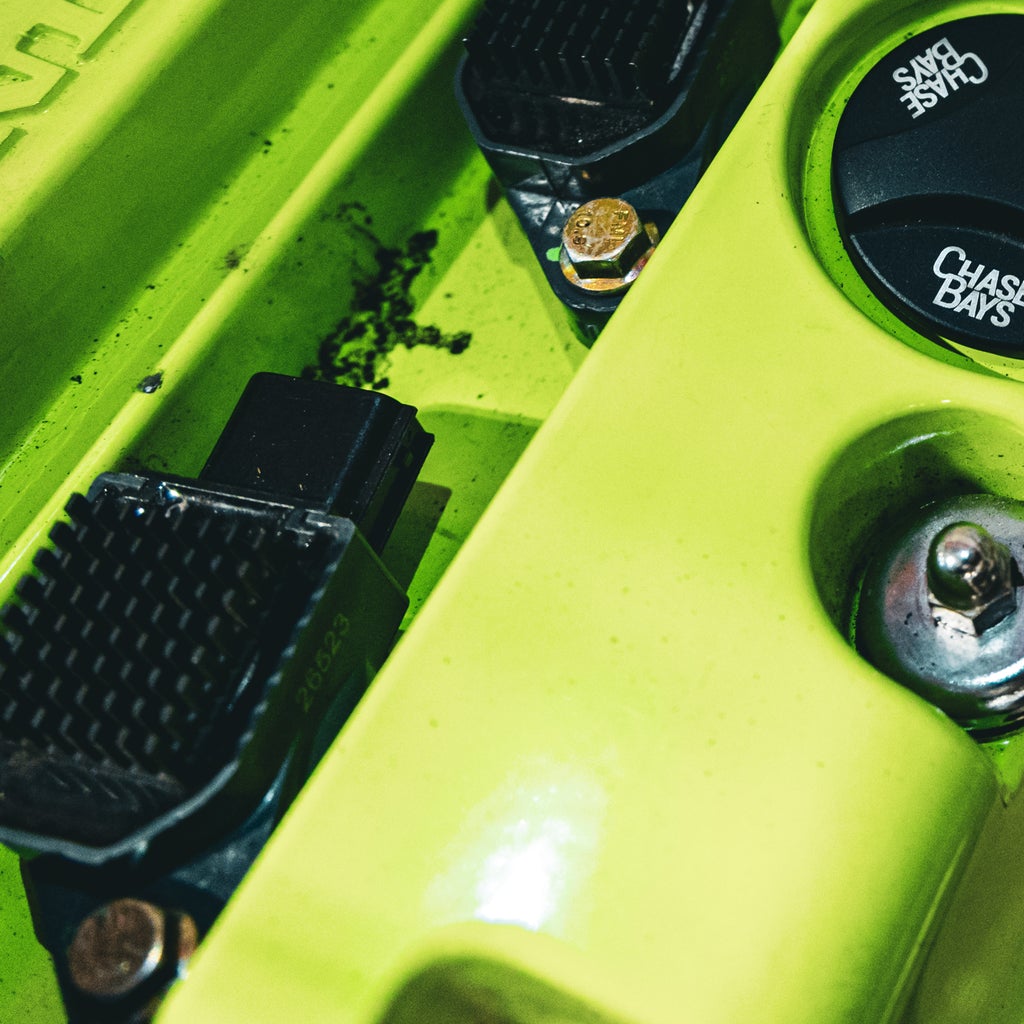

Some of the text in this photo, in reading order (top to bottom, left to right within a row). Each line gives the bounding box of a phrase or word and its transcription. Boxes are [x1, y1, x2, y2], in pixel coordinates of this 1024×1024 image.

[892, 37, 962, 92] BAYS
[900, 52, 989, 119] CHASE
[932, 273, 1016, 328] BAYS
